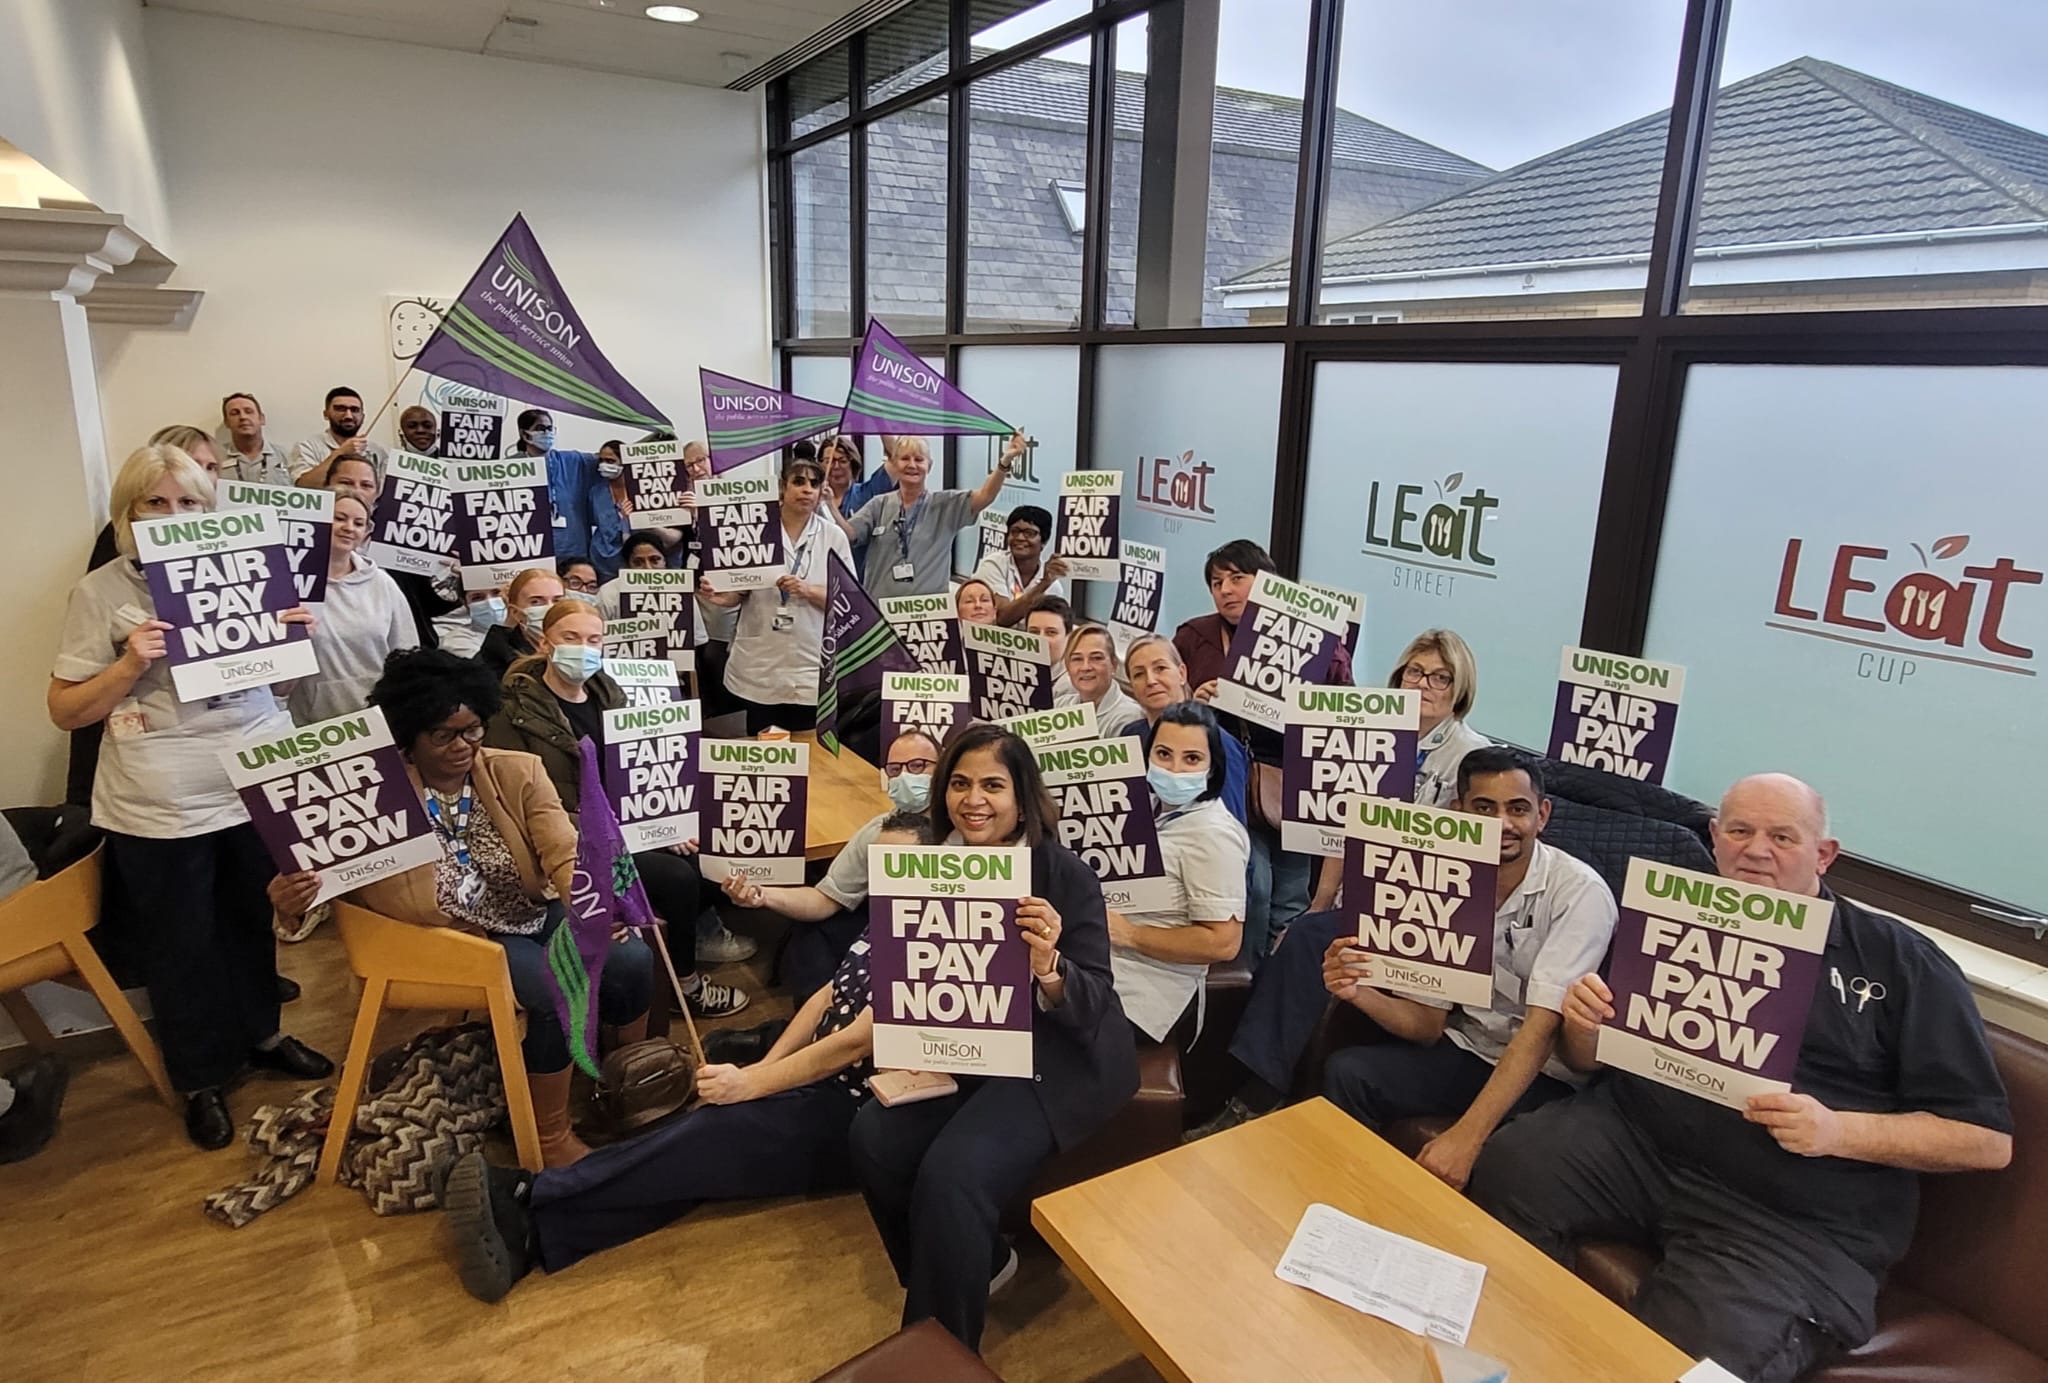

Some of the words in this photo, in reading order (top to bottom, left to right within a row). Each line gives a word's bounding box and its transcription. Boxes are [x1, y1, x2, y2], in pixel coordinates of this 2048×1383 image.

[491, 265, 582, 350] UNISON
[480, 290, 497, 306] the
[496, 302, 522, 328] public
[519, 323, 551, 350] service
[550, 346, 575, 368] union
[873, 353, 941, 395] UNISON
[448, 396, 497, 410] UNISON
[713, 395, 782, 411] UNISON
[449, 413, 494, 431] FAIR
[454, 428, 490, 445] PAY
[447, 442, 495, 460] NOW
[626, 443, 676, 457] UNISON
[398, 455, 448, 480] UNIS
[457, 462, 536, 482] UNISON
[631, 461, 677, 479] FAIR
[488, 479, 509, 487] says
[639, 477, 673, 494] PAY
[703, 480, 769, 497] UNISON
[1066, 474, 1114, 488] UNISON
[1137, 456, 1216, 514] LEat
[229, 486, 322, 510] UNISON
[465, 489, 536, 516] FAIR
[635, 492, 680, 510] NOW
[1065, 497, 1110, 517] FAIR
[276, 508, 288, 516] ys
[397, 502, 453, 531] PAY
[709, 504, 768, 526] FAIR
[1366, 481, 1499, 566] LEat
[148, 513, 265, 546] UNISON
[282, 520, 315, 547] IR
[384, 521, 456, 554] NOW
[477, 512, 533, 539] PAY
[718, 524, 766, 547] PAY
[1068, 516, 1106, 537] PAY
[1163, 518, 1183, 535] CUP
[197, 538, 228, 552] says
[470, 534, 544, 563] NOW
[983, 528, 1005, 549] FAIR
[1061, 535, 1112, 557] NOW
[396, 555, 431, 568] UNISON
[712, 543, 775, 567] NOW
[1125, 543, 1160, 564] UNISON
[165, 550, 271, 593] FAIR
[493, 571, 521, 581] UNIS
[627, 573, 685, 585] UNISON
[1124, 565, 1157, 591] FAIR
[1393, 566, 1456, 598] STREET
[187, 581, 267, 624] PAY
[630, 593, 683, 611] FAIR
[887, 597, 948, 614] UNISON
[1125, 584, 1154, 609] PAY
[1263, 578, 1339, 621] UNISON
[1774, 538, 2043, 659] LEat
[1116, 602, 1154, 629] NOW
[1286, 605, 1307, 619] says
[180, 611, 287, 658] NOW
[893, 620, 949, 642] FAIR
[972, 626, 1040, 653] UNISON
[1252, 607, 1324, 655] FAIR
[603, 640, 657, 659] FAIR
[1252, 635, 1314, 675] PAY
[220, 660, 274, 680] UNISON
[611, 663, 669, 677] UNISON
[920, 660, 956, 674] OW
[977, 652, 1038, 686] FAIR
[1572, 653, 1669, 688] UNISON
[1857, 652, 1916, 685] CUP
[625, 687, 672, 706] FAIR
[891, 677, 959, 692] UNISON
[986, 676, 1036, 706] PAY
[1604, 679, 1630, 691] says
[892, 702, 954, 724] FAIR
[980, 696, 1036, 720] NO
[1243, 698, 1280, 720] UNISON
[1299, 690, 1405, 715] UNISON
[1570, 685, 1657, 730] FAIR
[614, 705, 690, 731] UNISON
[1336, 715, 1365, 725] says
[237, 717, 371, 770] UNISON
[642, 727, 663, 736] says
[1033, 734, 1056, 744] says
[1575, 716, 1649, 757] PAY
[619, 735, 688, 769] FAIR
[710, 744, 797, 764] UNISON
[1301, 727, 1396, 763] FAIR
[294, 752, 330, 767] says
[741, 764, 765, 772] says
[1560, 742, 1653, 781] NOW
[261, 755, 384, 813] FAIR
[629, 761, 684, 794] PAY
[1067, 769, 1094, 780] says
[1311, 760, 1390, 795] PAY
[713, 774, 791, 802] FAIR
[291, 786, 380, 839] PAY
[620, 785, 694, 822] NOW
[722, 802, 786, 829] PAY
[1298, 790, 1347, 824] NO
[640, 825, 677, 841] UNISON
[1057, 814, 1128, 849] PAY
[1360, 802, 1482, 845] UNISON
[289, 809, 408, 871] NOW
[711, 828, 795, 854] NOW
[1321, 837, 1345, 848] UNI
[1401, 835, 1435, 849] says
[339, 856, 396, 882] UNISON
[731, 866, 771, 877] UNISON
[884, 853, 1012, 880] UNISON
[1080, 844, 1147, 878] OW
[1362, 843, 1472, 898] FAIR
[930, 882, 966, 895] says
[1104, 891, 1131, 904] SON
[1645, 869, 1808, 930] UNISON
[1373, 882, 1465, 929] PAY
[891, 899, 1006, 941] FAIR
[1697, 911, 1741, 930] says
[1358, 914, 1476, 966] NOW
[1641, 916, 1786, 989] FAIR
[906, 941, 999, 982] PAY
[1385, 968, 1442, 988] UNISON
[891, 981, 1014, 1024] NOW
[1650, 961, 1771, 1024] PAY
[1625, 993, 1780, 1071] NOW
[923, 1042, 982, 1057] UNISON
[1654, 1058, 1725, 1092] UNISON
